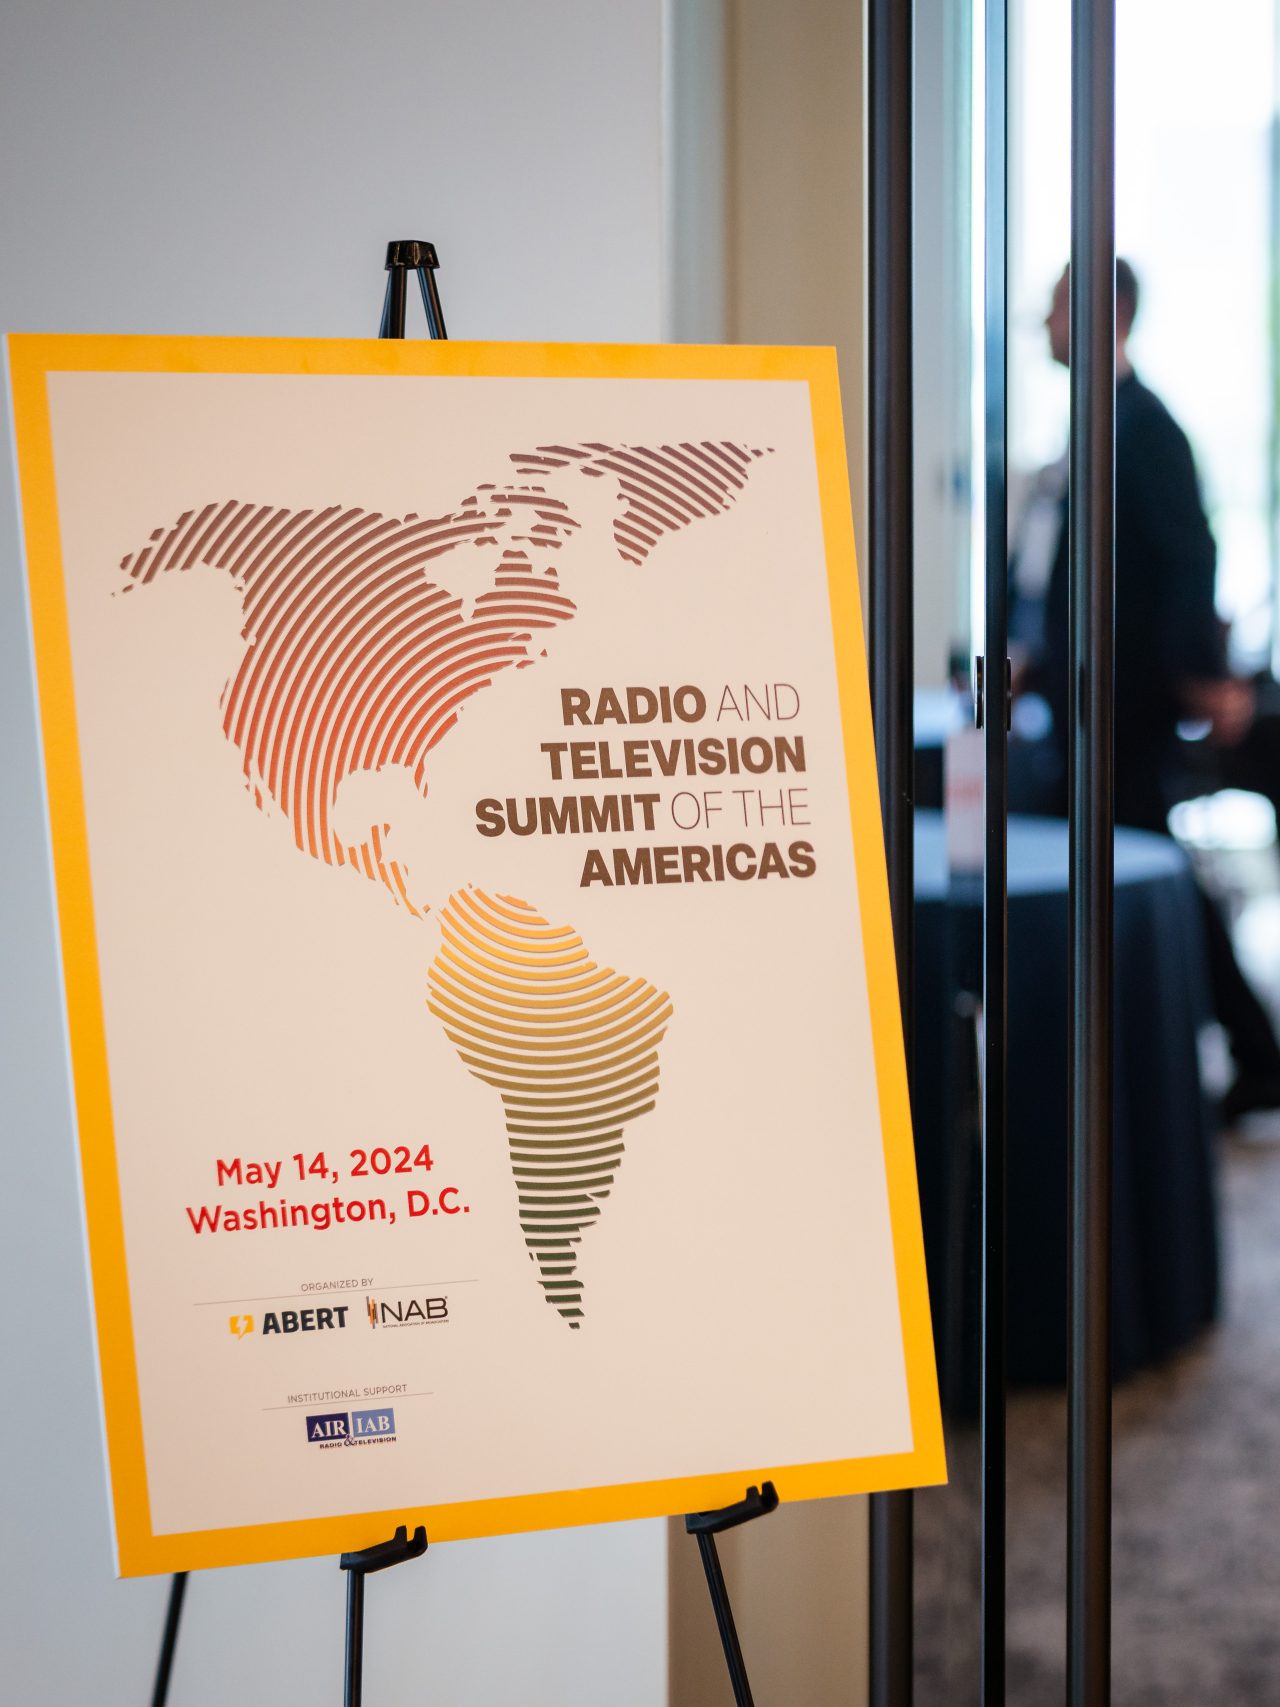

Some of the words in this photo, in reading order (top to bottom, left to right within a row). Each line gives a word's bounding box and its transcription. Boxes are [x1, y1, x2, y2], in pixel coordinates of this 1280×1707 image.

[561, 685, 706, 725] RADIO
[717, 683, 800, 722] AND
[540, 736, 806, 780] TELEVISION
[476, 793, 660, 837] SUMMIT
[671, 791, 723, 830] OF
[732, 788, 811, 827] THE
[580, 841, 816, 887] AMERICAS
[217, 1158, 282, 1189] May
[293, 1152, 338, 1184] 14,
[350, 1145, 434, 1176] 2024
[186, 1197, 396, 1234] Washington,
[407, 1187, 470, 1217] D.C.
[301, 1280, 359, 1292] ORGANIZED
[361, 1278, 374, 1287] BY
[263, 1306, 348, 1335] ABERT
[381, 1297, 449, 1323] NAB
[288, 1389, 361, 1403] INSTITUTIONAL
[364, 1384, 407, 1397] SUPPORT
[311, 1420, 347, 1438] AIR
[356, 1416, 390, 1433] IAB
